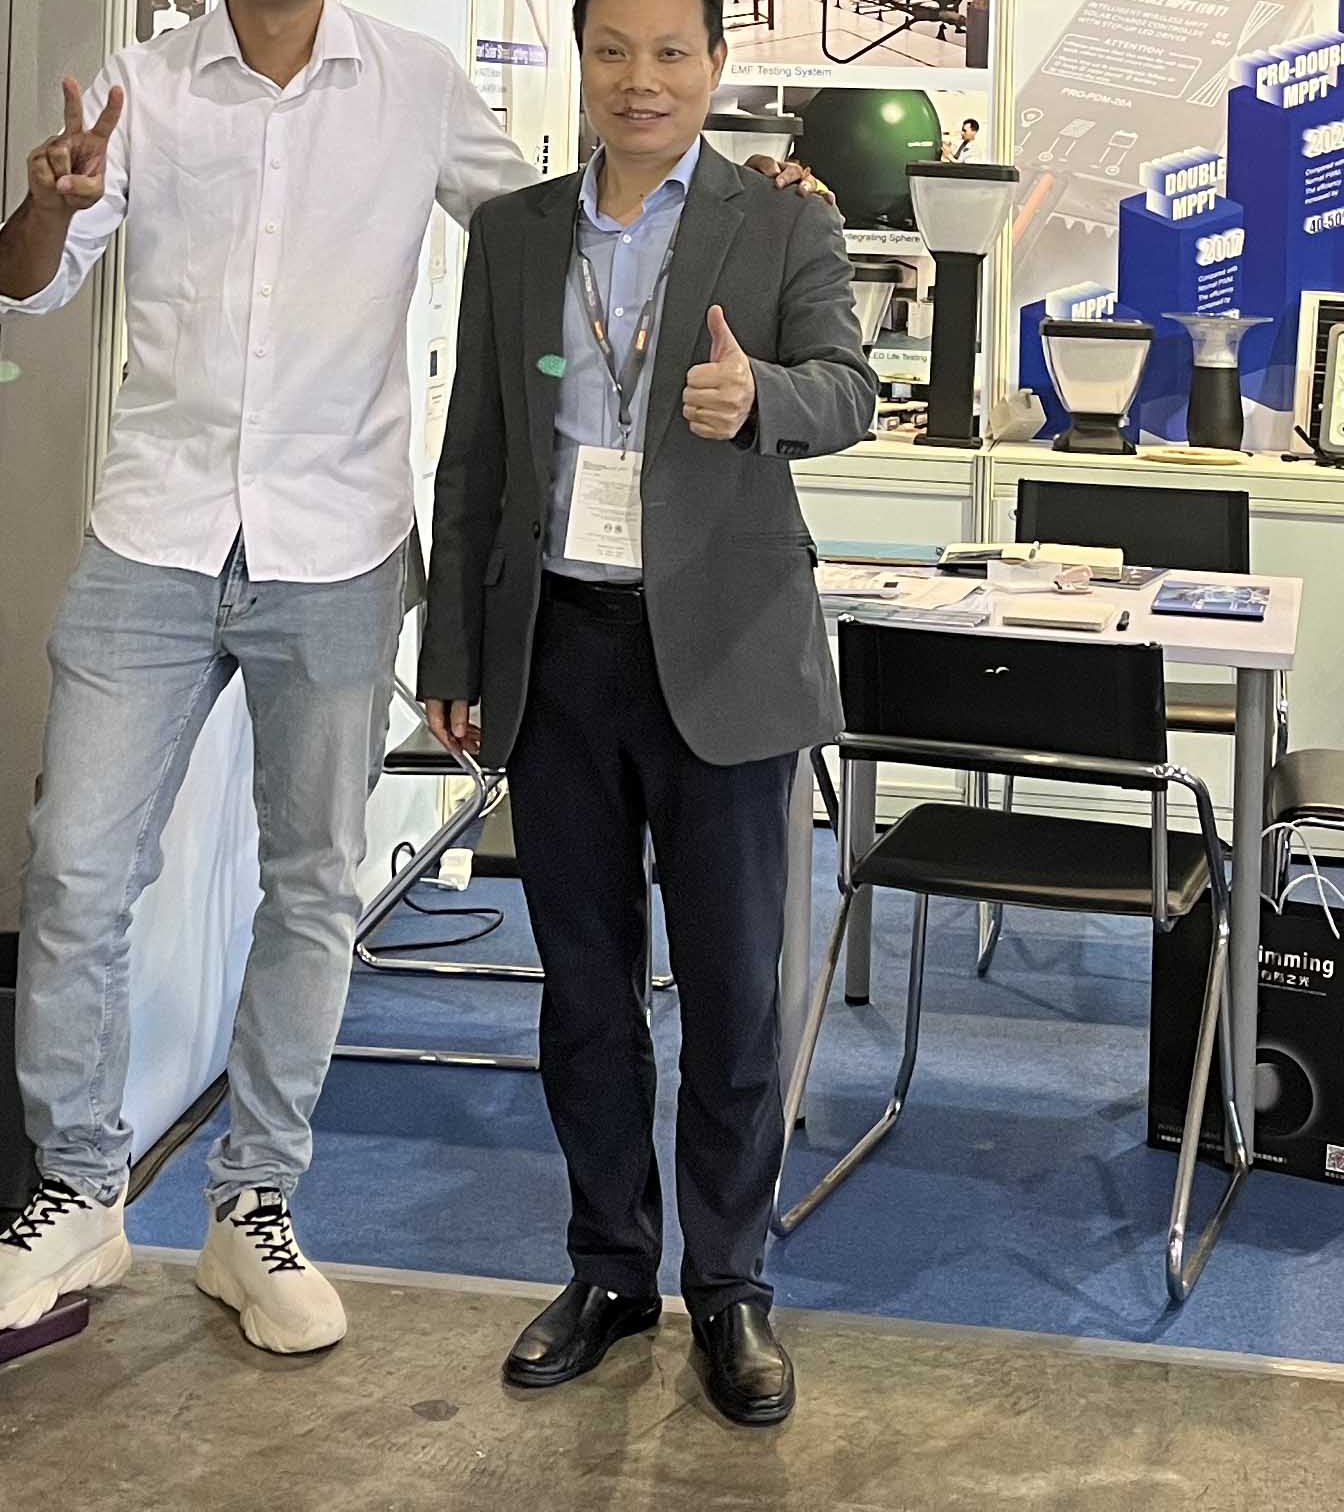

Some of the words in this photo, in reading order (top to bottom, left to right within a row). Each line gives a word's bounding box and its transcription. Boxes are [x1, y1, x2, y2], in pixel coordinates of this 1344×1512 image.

[1283, 74, 1328, 109] MPPT
[1165, 158, 1225, 196] DOUBLE
[1172, 188, 1217, 221] MPPT
[1071, 291, 1118, 321] MPPT
